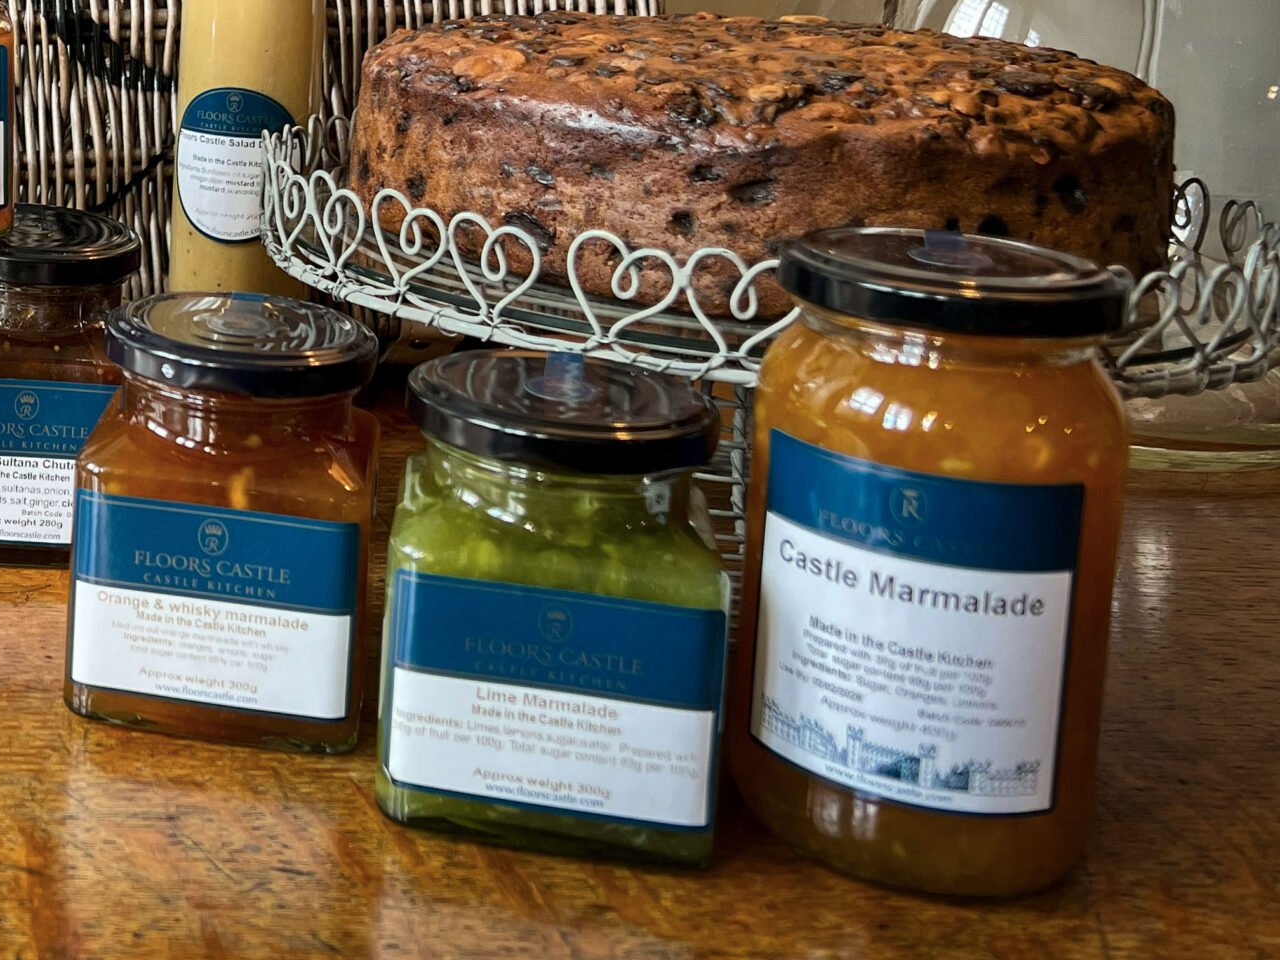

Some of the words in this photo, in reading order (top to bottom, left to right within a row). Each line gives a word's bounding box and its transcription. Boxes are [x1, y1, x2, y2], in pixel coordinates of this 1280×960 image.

[196, 111, 234, 124] FLOORS
[199, 136, 226, 146] Castle
[229, 139, 255, 148] Salad
[29, 424, 89, 439] CASTLE
[22, 442, 77, 451] KITCHEN
[12, 471, 37, 481] Castle
[39, 473, 70, 482] Kitchen
[4, 518, 36, 527] weight
[39, 520, 63, 529] 280g
[134, 550, 212, 578] FLOORS
[216, 561, 290, 585] CASTLE
[779, 539, 859, 589] Castle
[869, 571, 1045, 618] Marmalade
[144, 572, 198, 588] CASTLE
[208, 579, 276, 598] KITCHEN
[98, 590, 150, 609] Orange
[153, 598, 165, 610] &
[170, 600, 221, 620] whisky
[225, 607, 309, 632] marmalade
[465, 636, 553, 666] FLOORS
[559, 646, 646, 677] CASTLE
[138, 666, 182, 682] Approx
[229, 680, 258, 694] 300g
[476, 687, 518, 706] Lime
[522, 692, 619, 720] Marmalade
